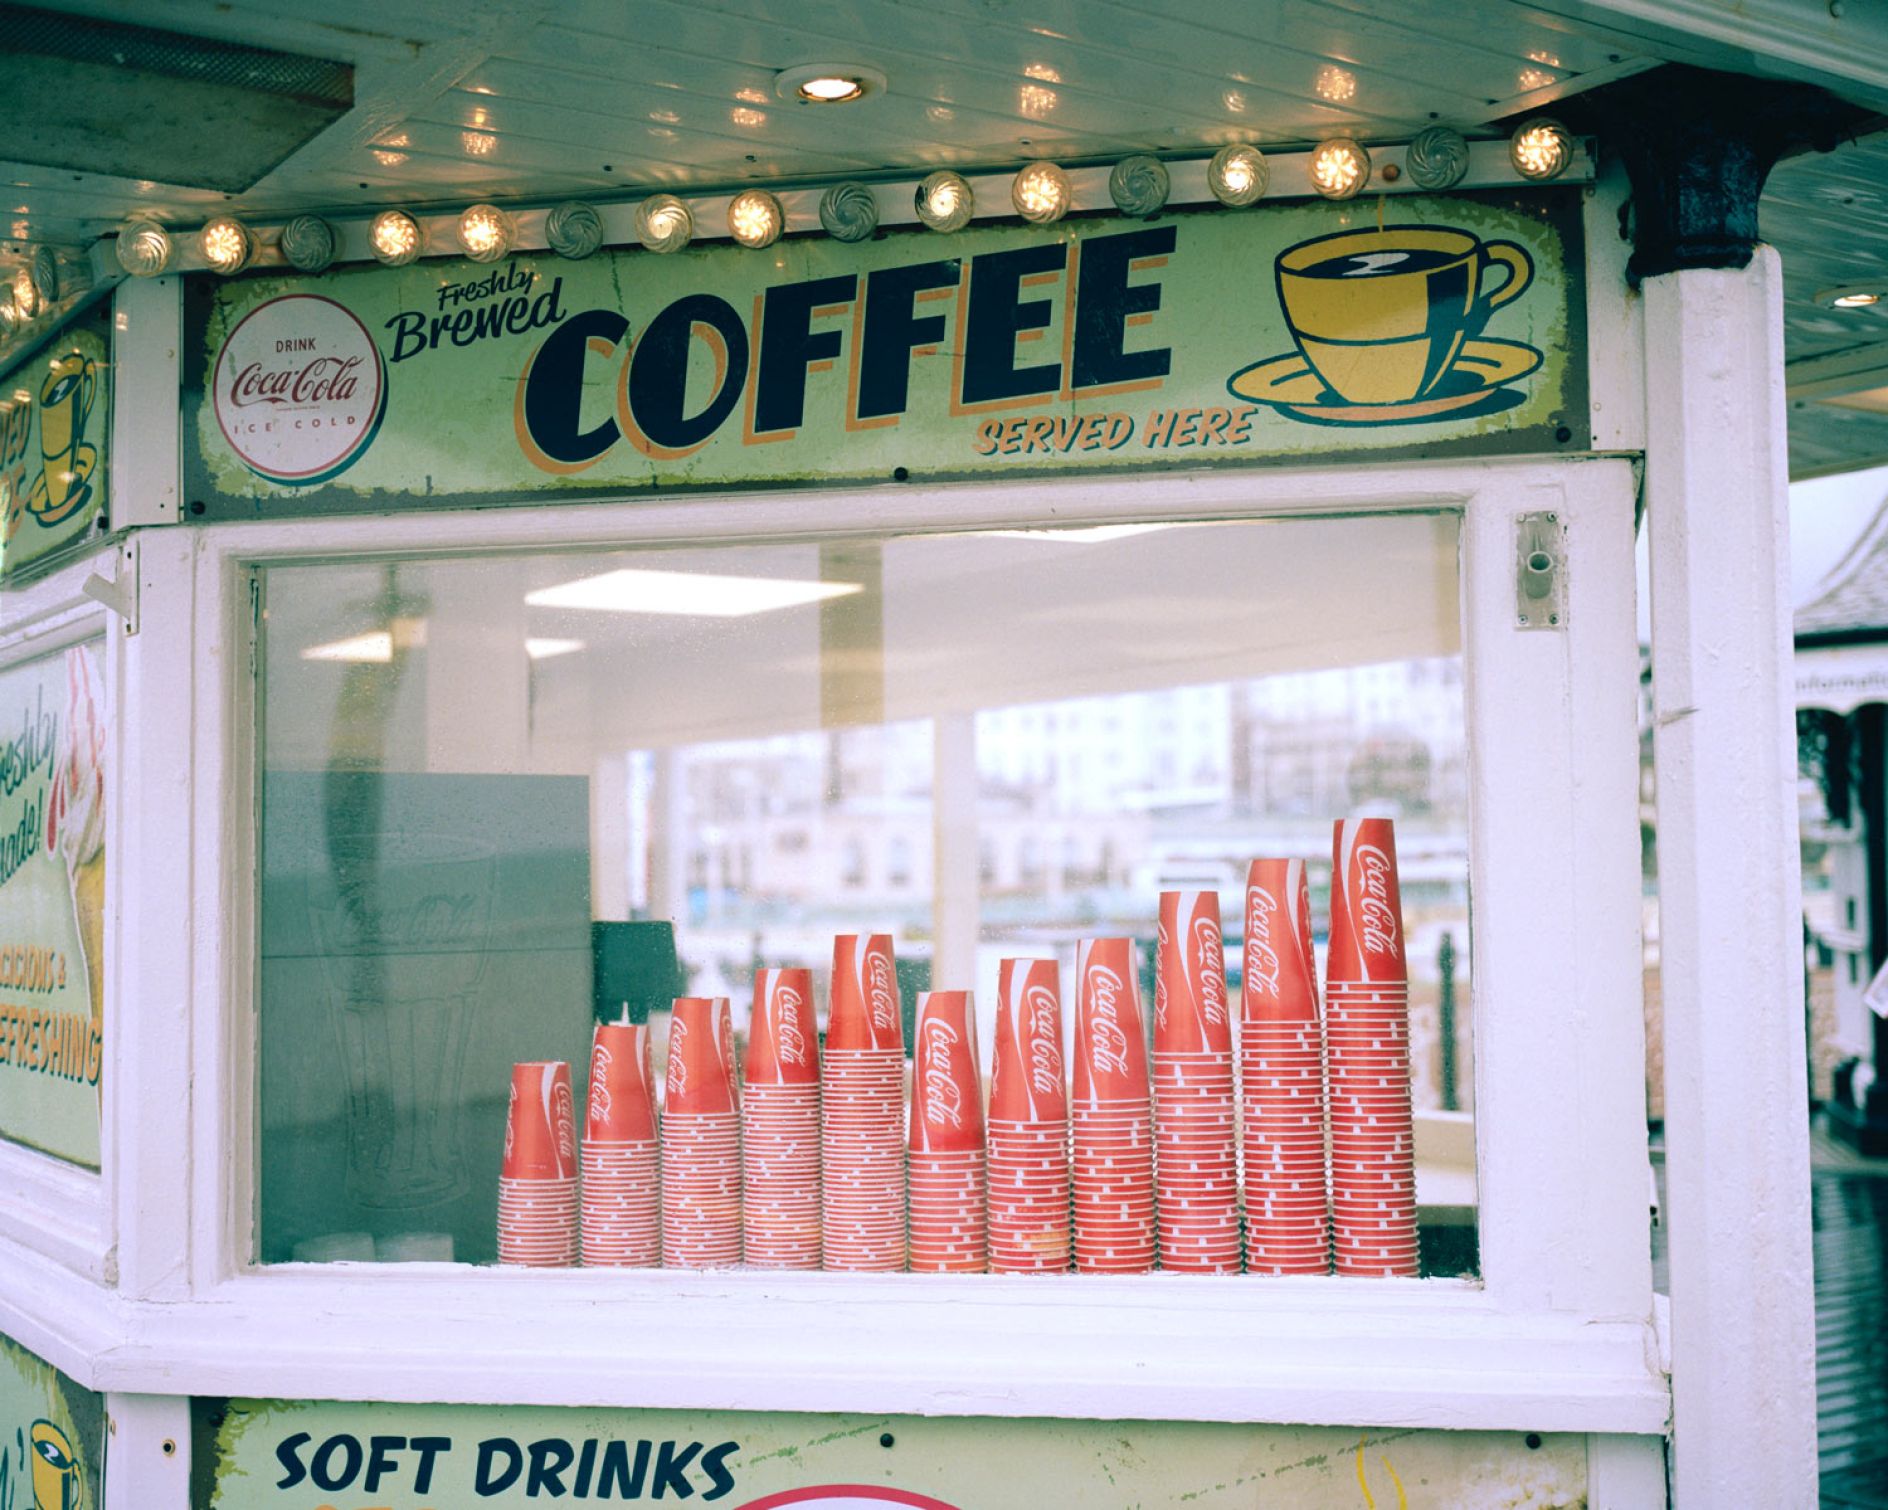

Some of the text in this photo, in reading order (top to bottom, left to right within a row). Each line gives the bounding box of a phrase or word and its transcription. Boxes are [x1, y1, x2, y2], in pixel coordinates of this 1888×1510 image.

[437, 261, 535, 311] Freshly
[276, 337, 316, 353] DRINK
[384, 277, 567, 363] Brewed
[514, 225, 1178, 474] COFFEE
[234, 416, 356, 435] ICE COLD
[972, 406, 1258, 455] SERVED HERE
[276, 1431, 741, 1501] SOFT DRINKS
